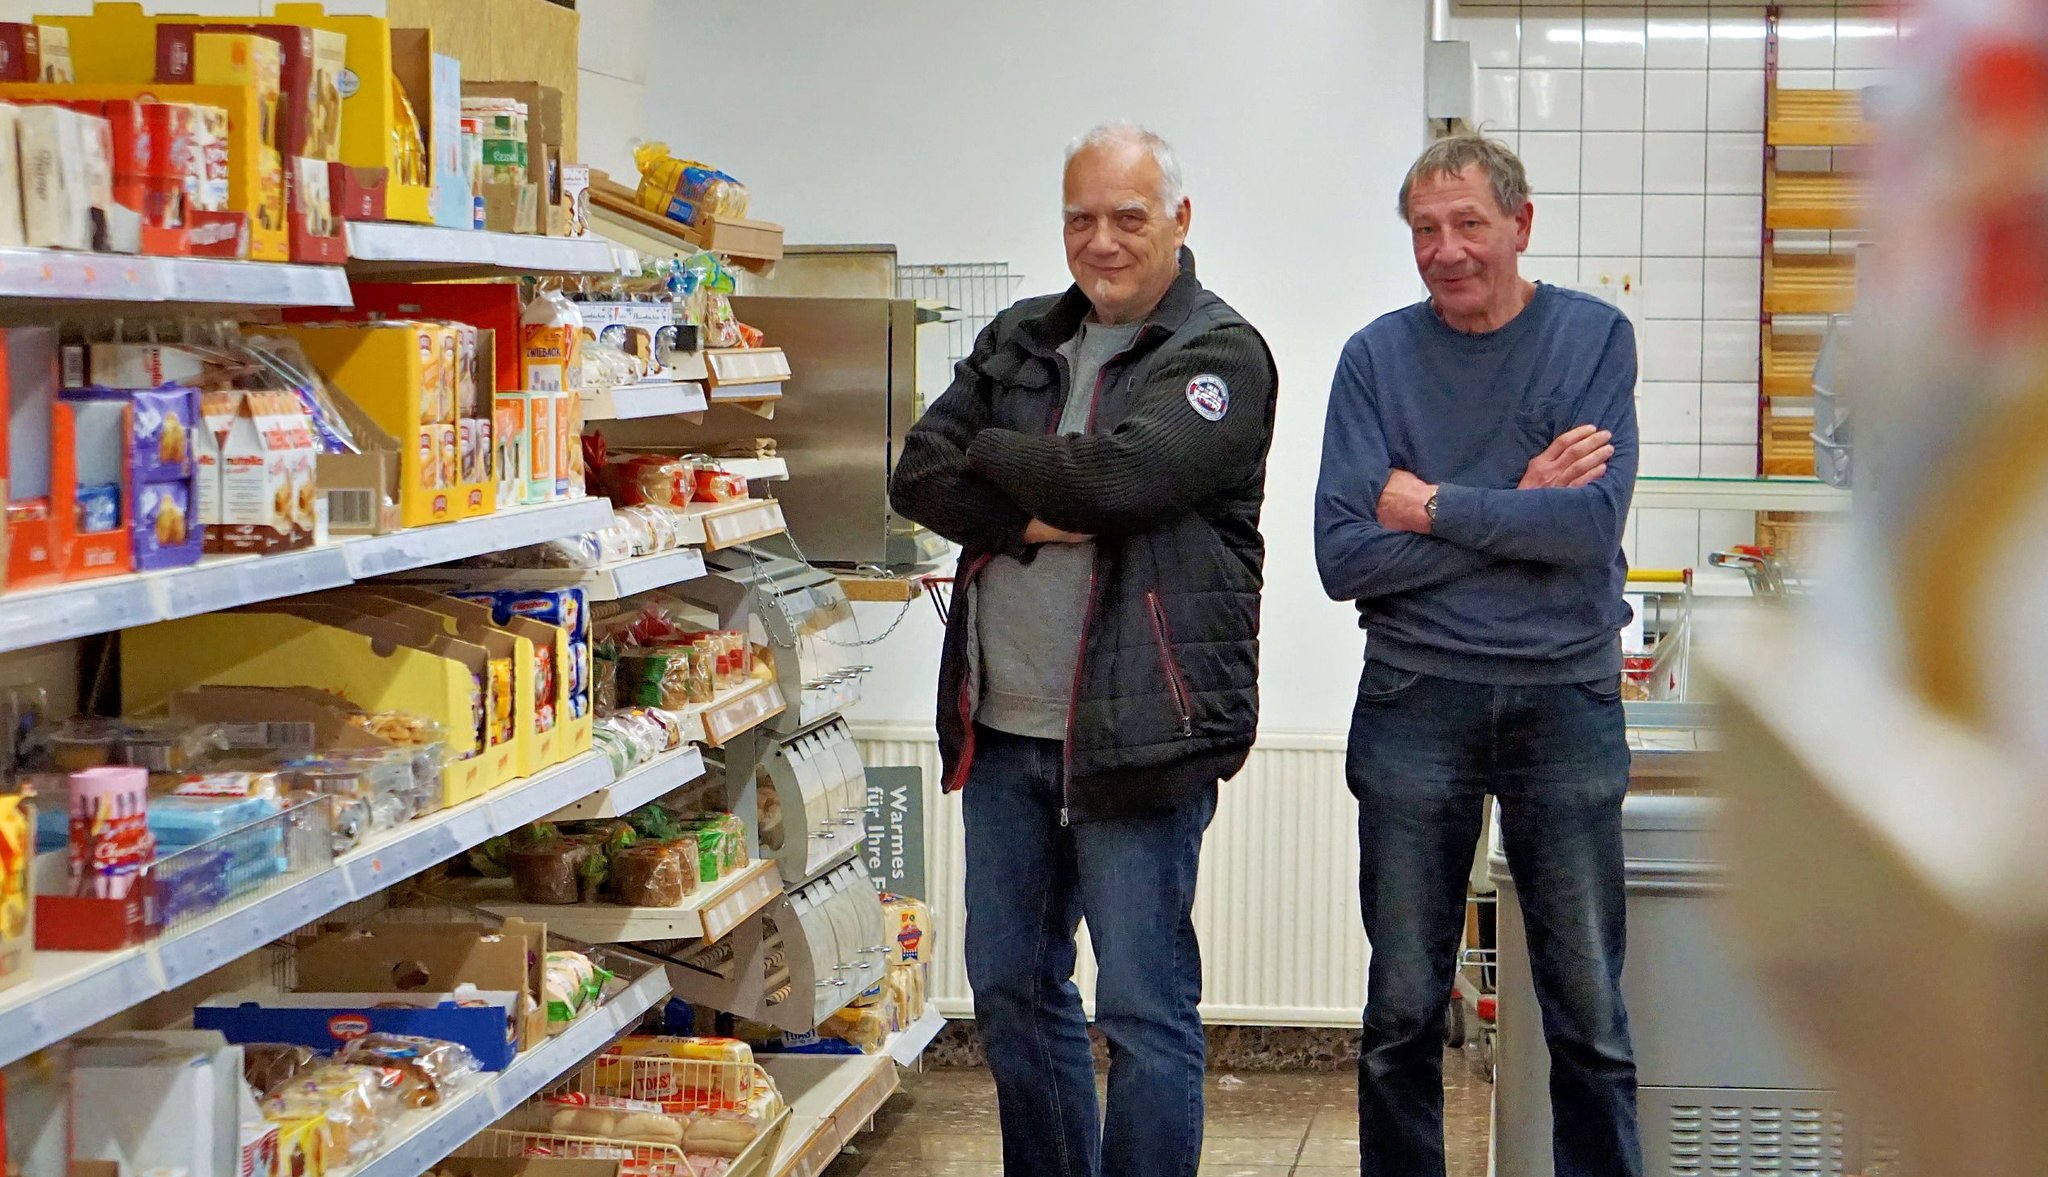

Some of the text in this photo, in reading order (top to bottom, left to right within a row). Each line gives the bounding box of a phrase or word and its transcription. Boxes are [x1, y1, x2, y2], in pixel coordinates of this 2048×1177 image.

[527, 347, 561, 358] ZWIEBACK
[867, 786, 883, 818] für
[868, 826, 884, 868] Ihre
[890, 785, 907, 879] Warmes
